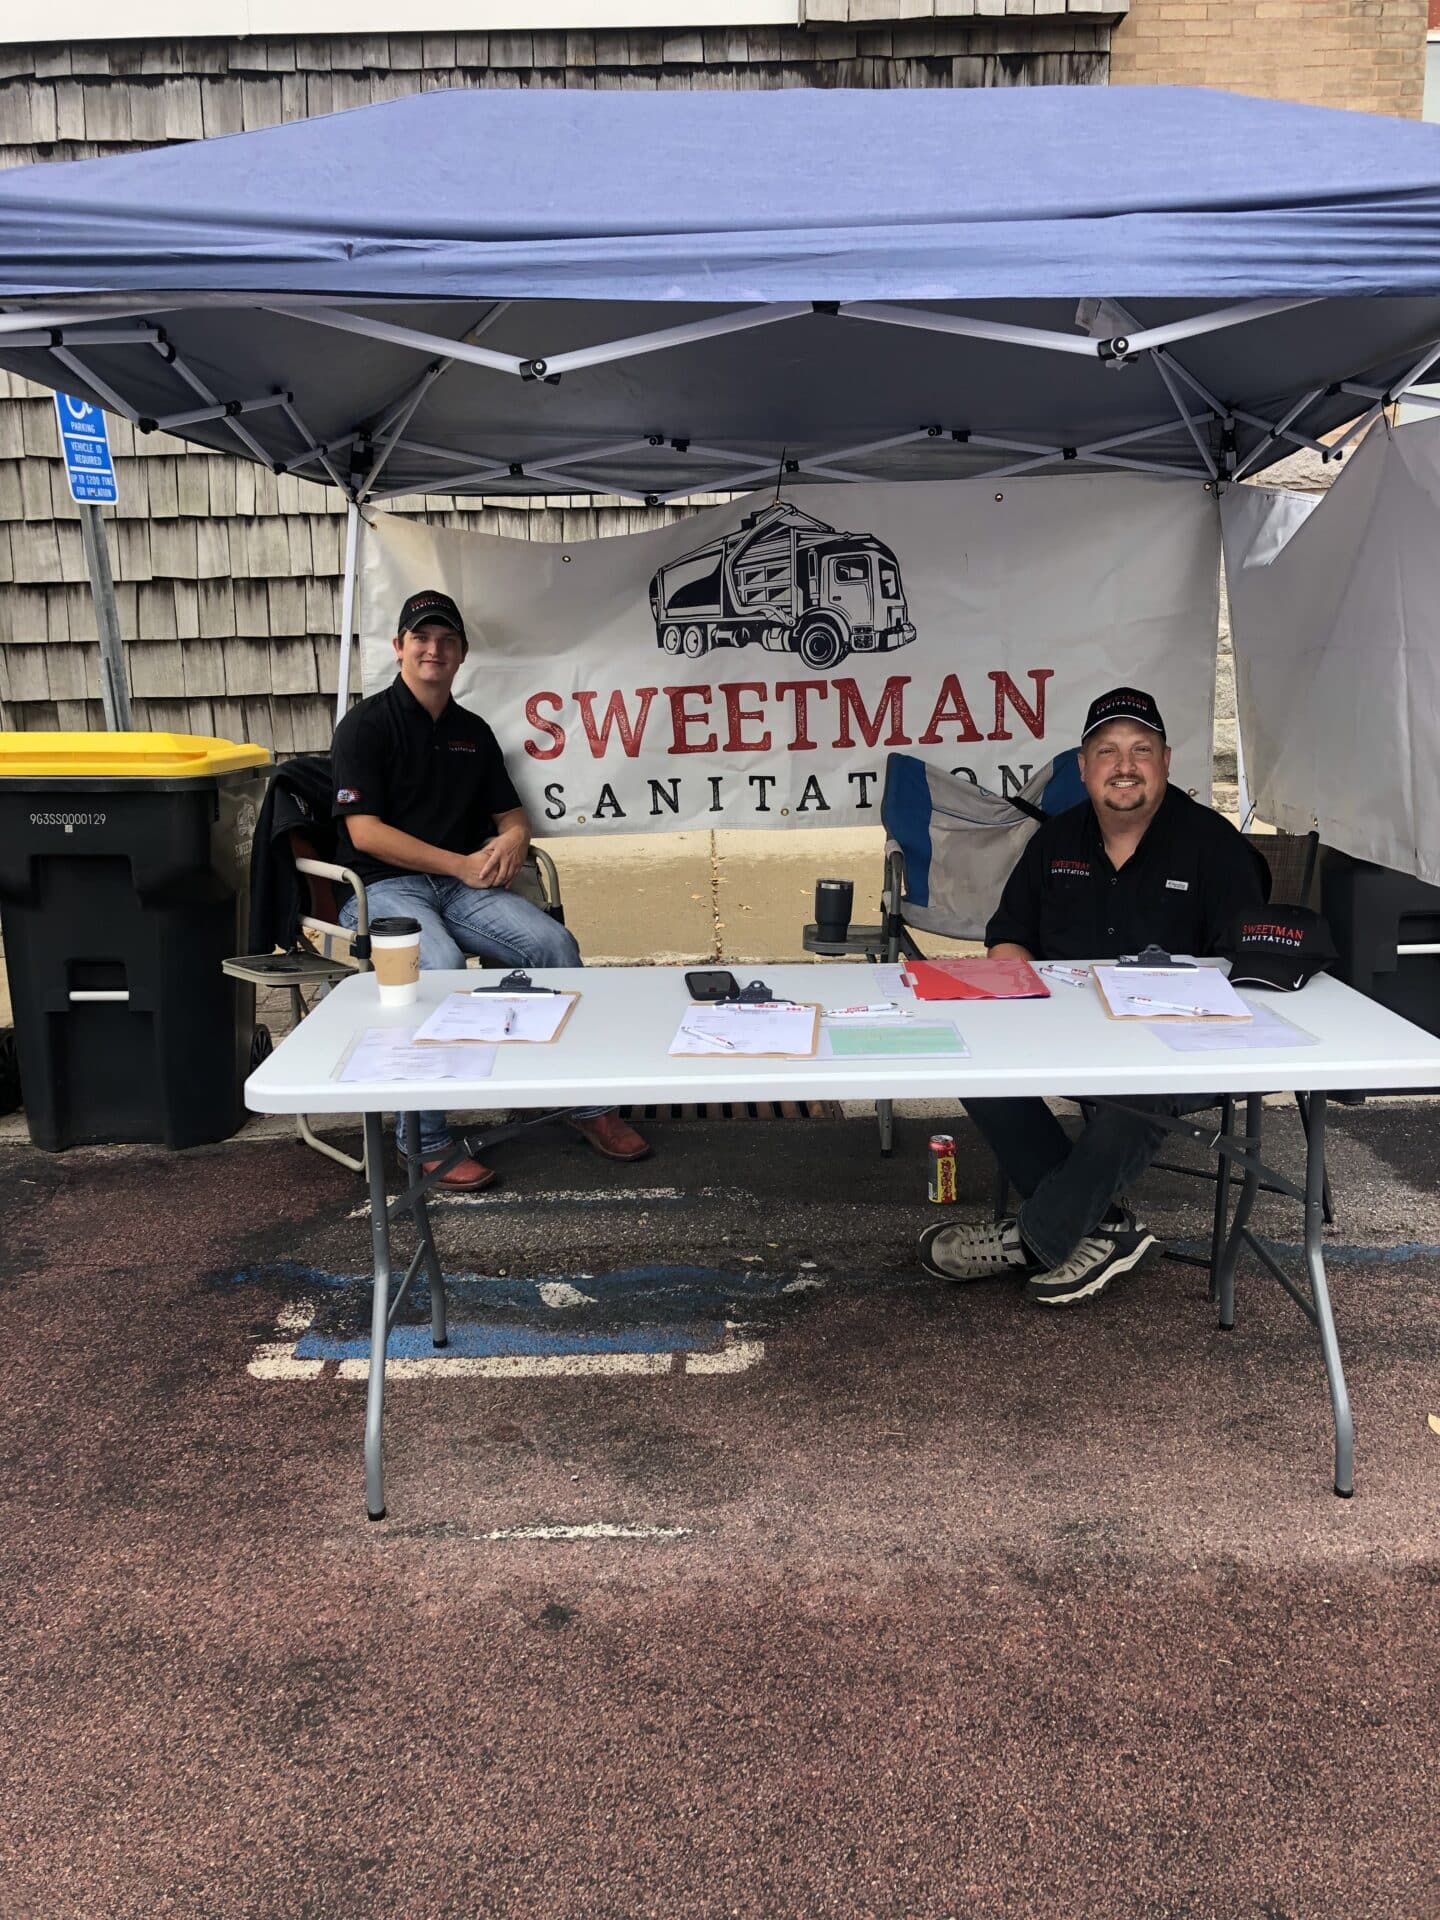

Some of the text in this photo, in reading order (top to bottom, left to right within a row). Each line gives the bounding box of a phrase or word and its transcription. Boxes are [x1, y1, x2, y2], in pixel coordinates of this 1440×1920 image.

[71, 421, 95, 434] PARKING
[71, 441, 94, 453] VEHICLE
[74, 454, 102, 466] REQUIRED
[1096, 700, 1148, 715] SANITATION
[524, 669, 1054, 760] SWEETMAN
[544, 764, 1034, 820] SANITATN
[1051, 868, 1090, 877] SANITATION
[1242, 924, 1304, 940] SWEETMAN
[1242, 935, 1301, 947] SANITATION
